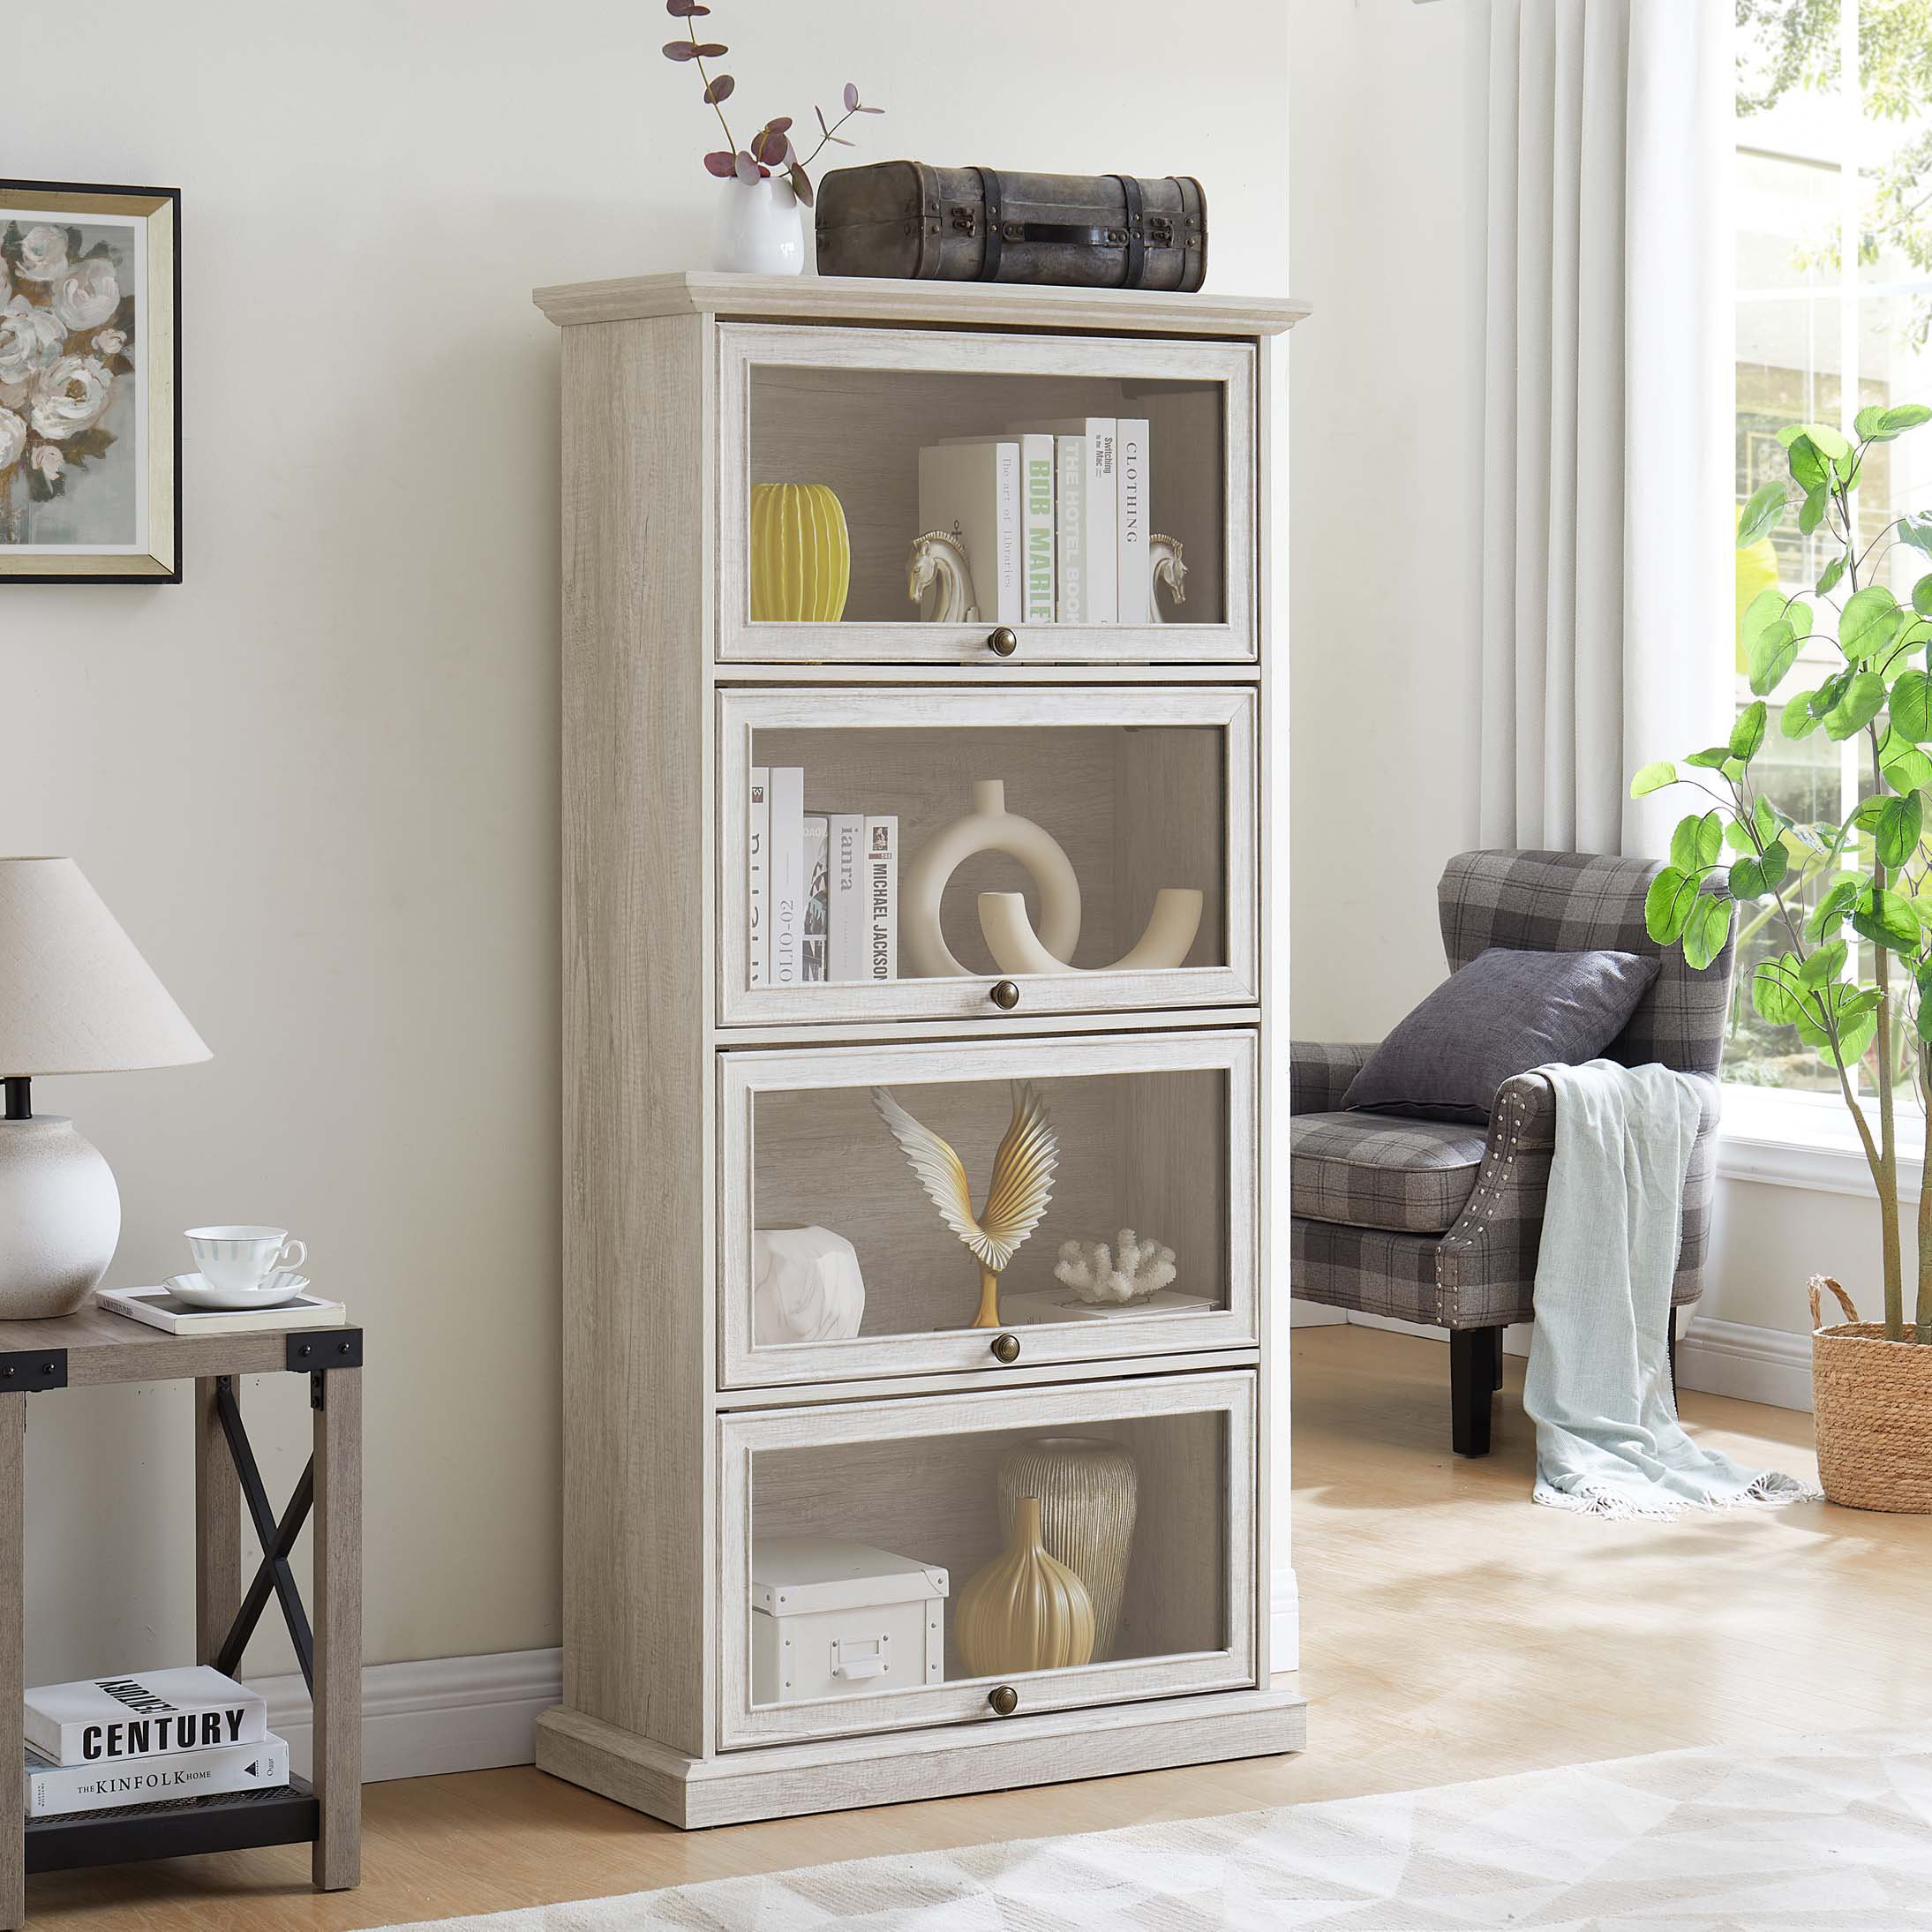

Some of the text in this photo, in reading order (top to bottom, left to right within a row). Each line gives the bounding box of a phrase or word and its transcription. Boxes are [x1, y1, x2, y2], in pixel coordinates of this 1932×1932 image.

[1065, 442, 1080, 485] THE
[1095, 450, 1104, 467] Mac
[1103, 437, 1114, 475] Switching
[1126, 442, 1138, 544] CLOTHING
[1029, 460, 1052, 622] BOB MARLE
[1065, 491, 1080, 562] HOTEL
[873, 863, 888, 921] MICHAEL
[94, 1679, 179, 1715] CENTURY
[82, 1709, 245, 1760] CENTURY
[77, 1770, 212, 1794] THE KINFOLK HOME
